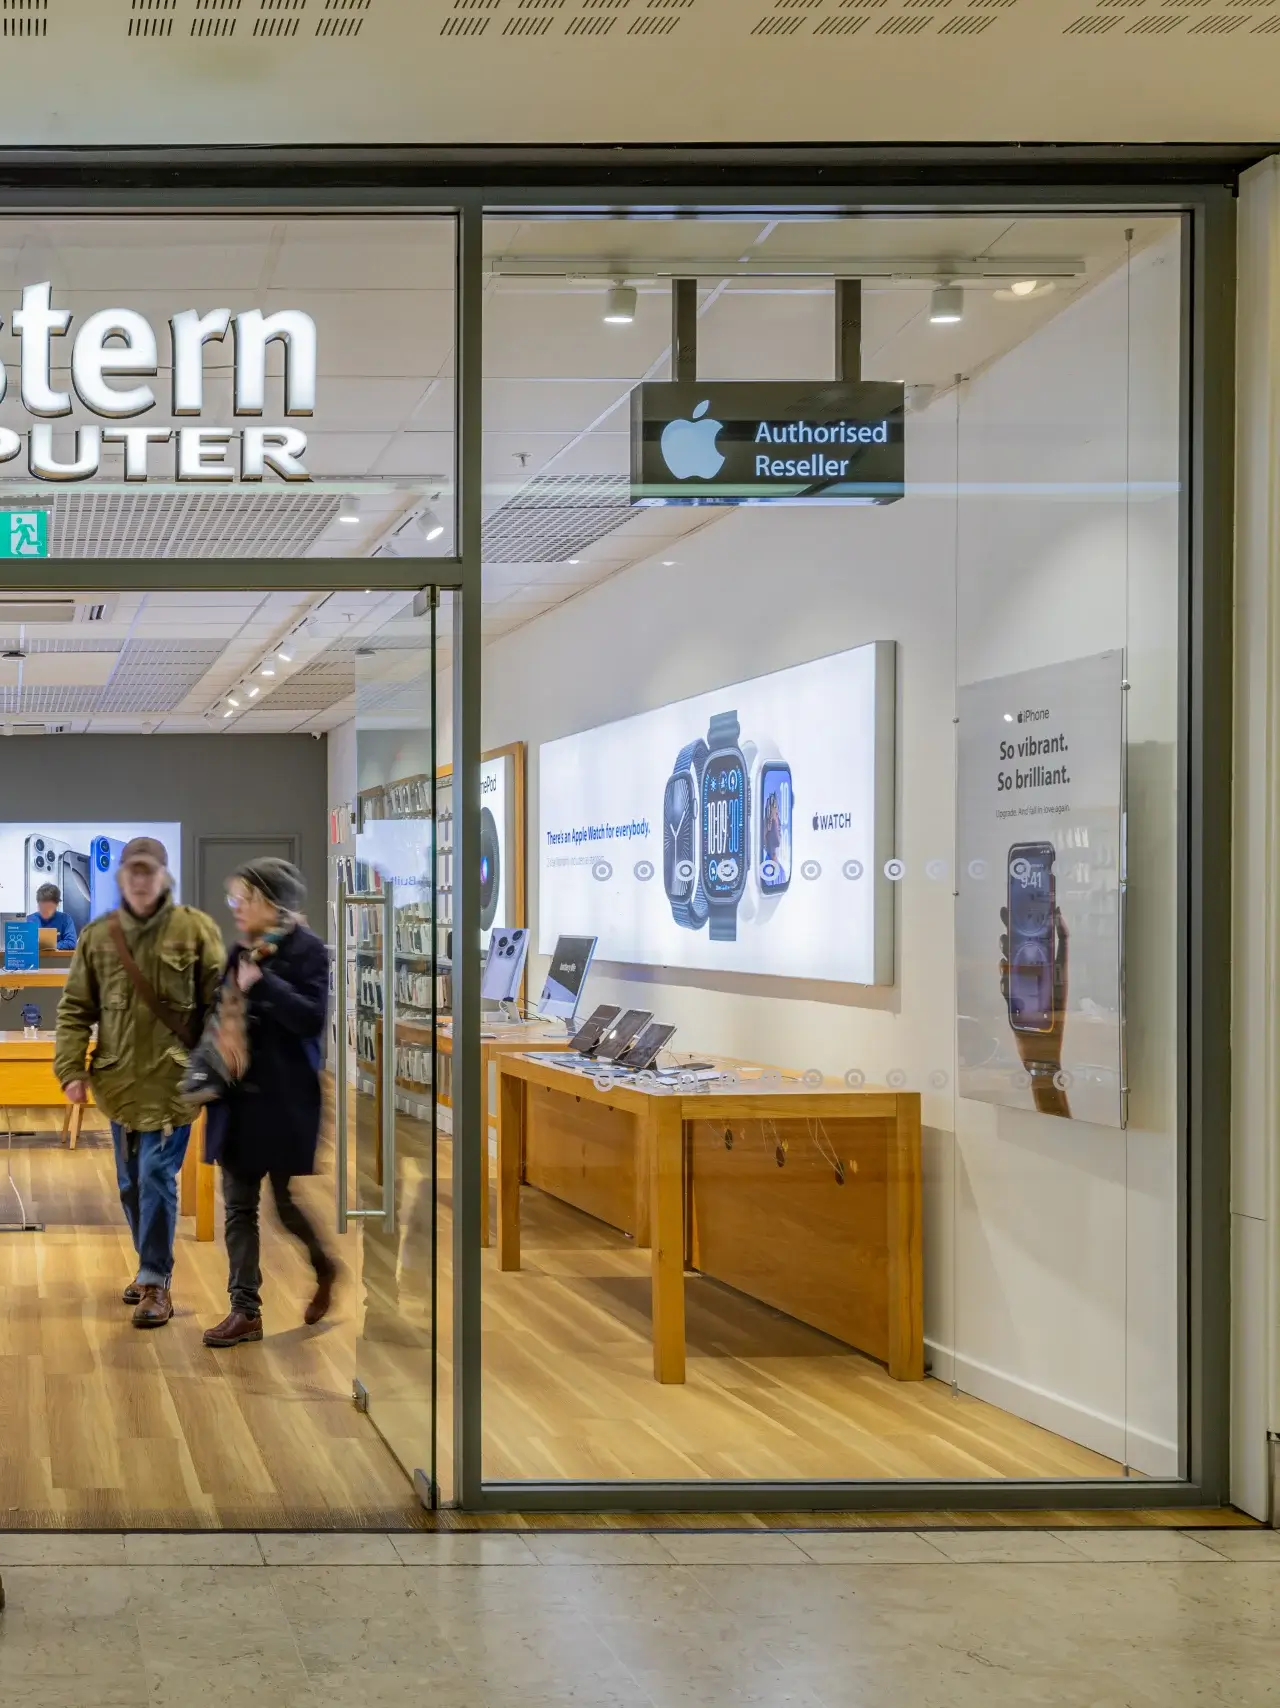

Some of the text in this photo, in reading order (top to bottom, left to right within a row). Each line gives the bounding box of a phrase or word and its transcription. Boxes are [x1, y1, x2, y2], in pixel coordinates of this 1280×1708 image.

[754, 420, 888, 444] Authorised
[754, 454, 850, 477] Reseller
[1023, 709, 1050, 723] iPhone
[999, 733, 1068, 761] So vibrant.
[997, 765, 1071, 792] So brilliant.
[547, 817, 651, 847] There's an Apple Watch for everybody.
[819, 812, 852, 831] WATCH
